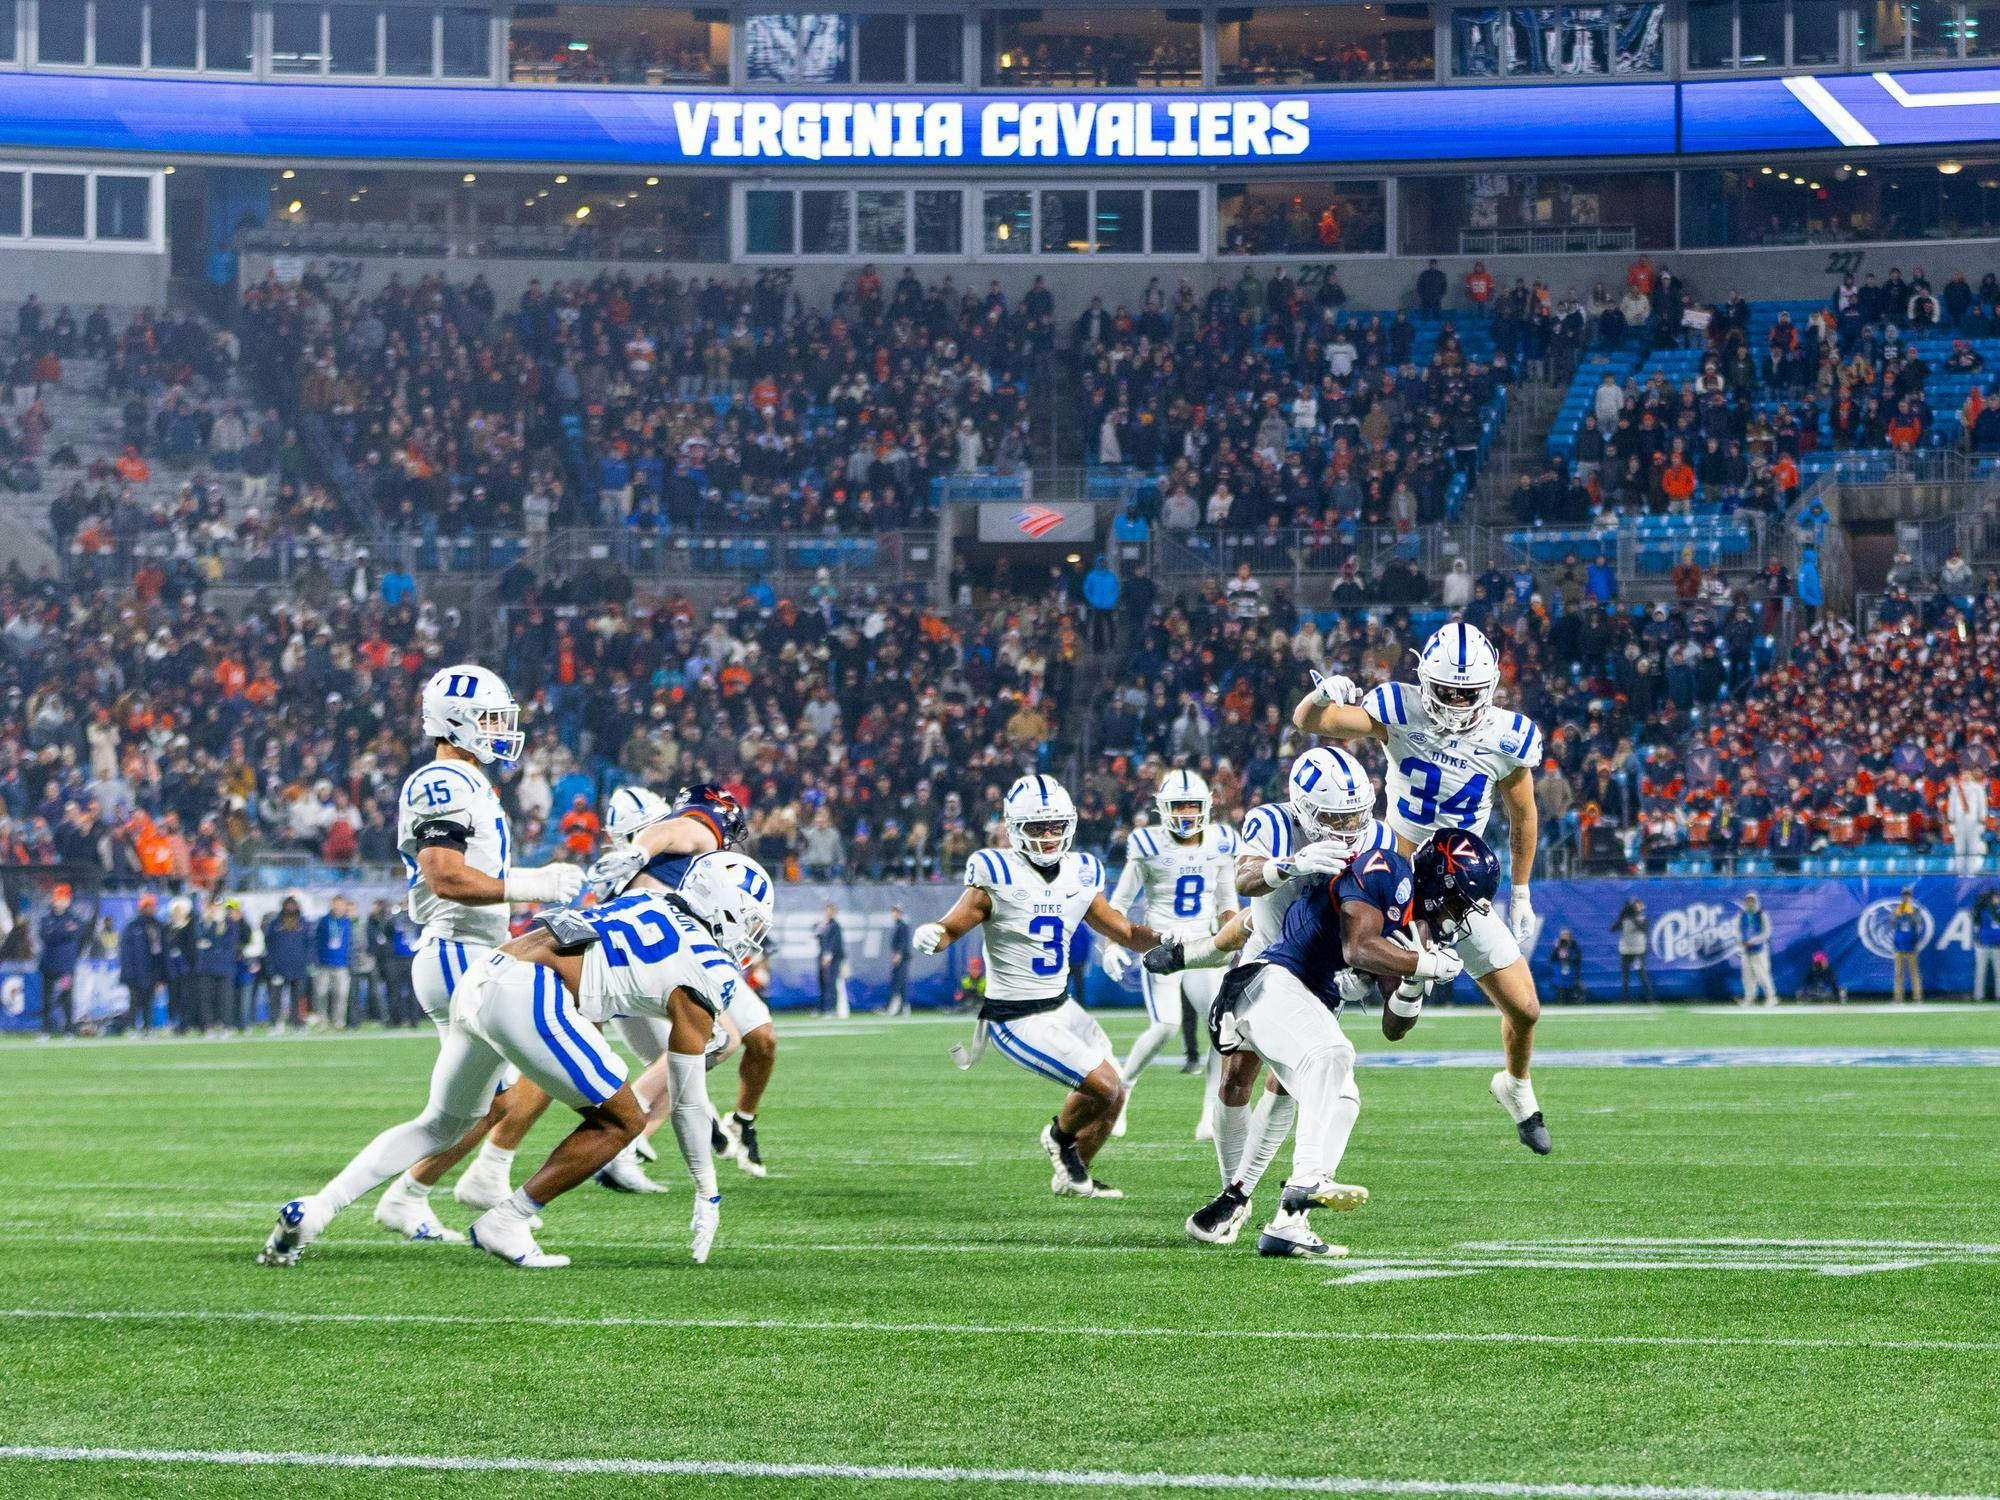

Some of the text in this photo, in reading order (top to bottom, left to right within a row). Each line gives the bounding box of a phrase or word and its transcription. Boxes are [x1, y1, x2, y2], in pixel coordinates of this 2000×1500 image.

[673, 100, 1311, 160] VIRGINIA CAVALIERS
[1431, 751, 1468, 769] DUKE
[424, 779, 452, 806] 15
[1397, 756, 1489, 829] 34
[1179, 866, 1203, 874] DUKE
[1033, 904, 1062, 914] DUKE
[1174, 875, 1205, 917] 8
[1687, 902, 1724, 935] Dr
[1029, 916, 1064, 976] 3
